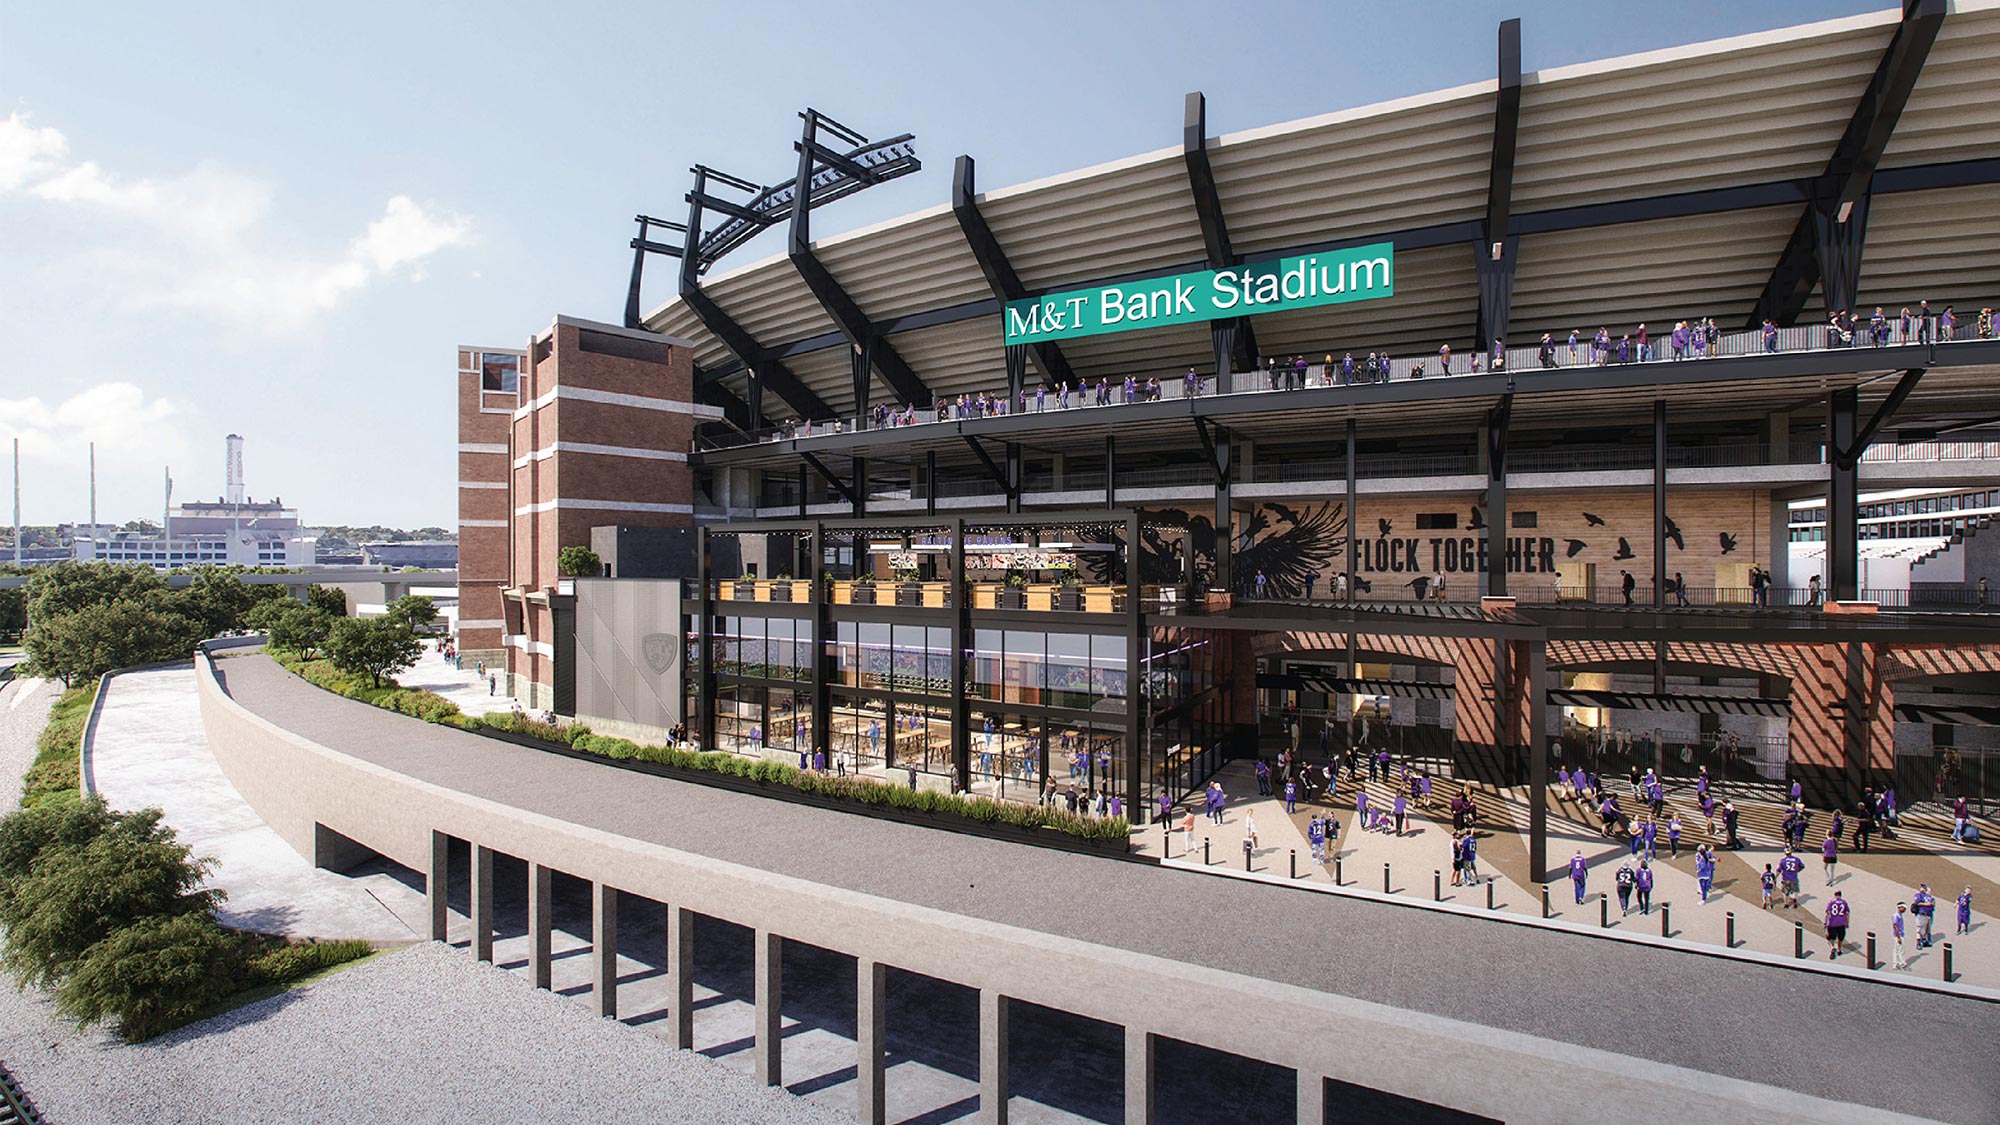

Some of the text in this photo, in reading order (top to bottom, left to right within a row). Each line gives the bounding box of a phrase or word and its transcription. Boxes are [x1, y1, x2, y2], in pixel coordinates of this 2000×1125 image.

[1008, 257, 1390, 337] M&T Bank Stadium
[976, 536, 1012, 545] RAVENS
[1354, 537, 1556, 572] FLOCK TOGEHER
[1312, 825, 1322, 835] 12
[1785, 861, 1796, 871] 52
[1619, 872, 1632, 884] 52
[1831, 903, 1845, 916] 82
